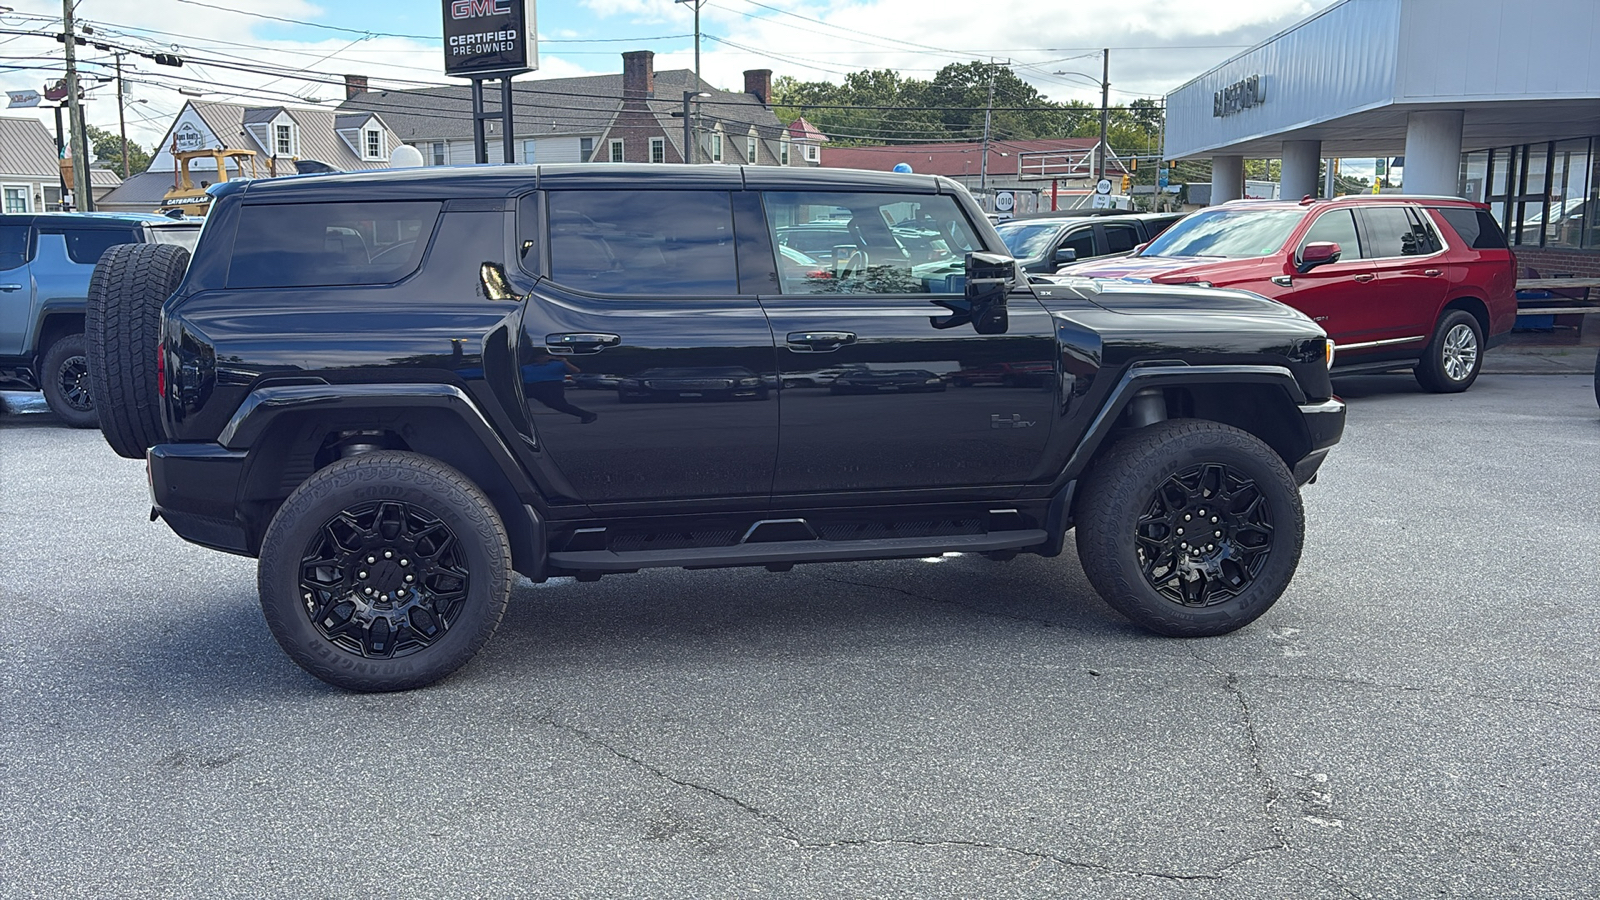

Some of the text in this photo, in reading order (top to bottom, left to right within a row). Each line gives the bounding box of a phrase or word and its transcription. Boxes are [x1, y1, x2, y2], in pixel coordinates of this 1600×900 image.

[452, 0, 511, 19] GMC
[449, 30, 517, 46] CERTIFIED
[453, 41, 514, 56] PRE-OWNED
[167, 196, 209, 205] CATERPILLAR
[998, 197, 1012, 206] 1010
[308, 638, 415, 676] WRANGLER
